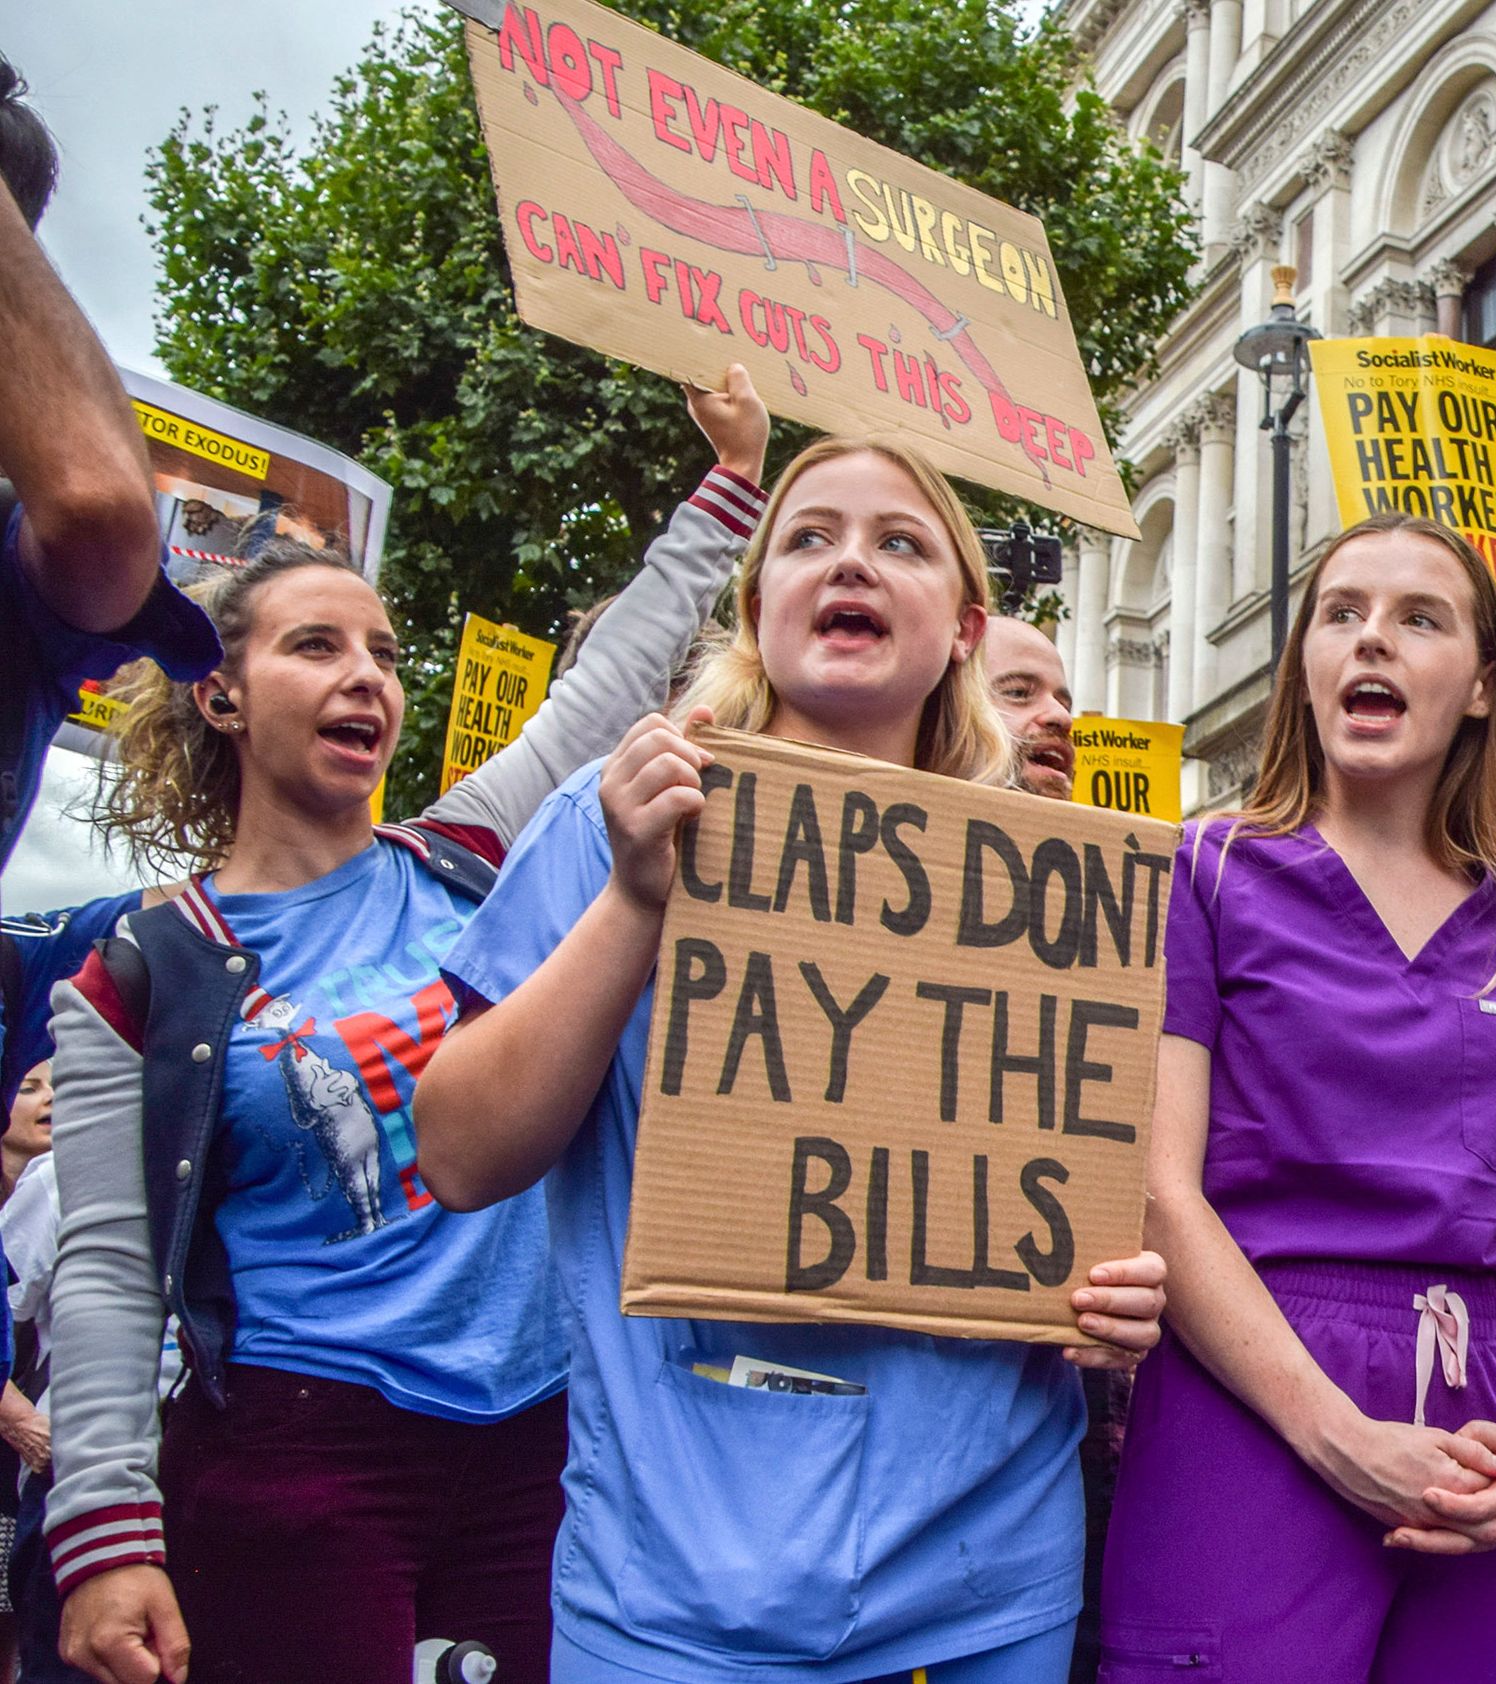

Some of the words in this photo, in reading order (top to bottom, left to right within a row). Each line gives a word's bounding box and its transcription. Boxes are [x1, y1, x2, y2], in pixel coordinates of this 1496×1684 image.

[498, 1, 623, 120] NOT
[647, 67, 797, 201] EVEN
[809, 147, 848, 225] A
[846, 168, 1058, 320] SURGEON
[515, 200, 626, 291] CAN
[639, 246, 734, 335] FIX
[739, 289, 842, 373] CUTS
[857, 333, 972, 425] THIS
[988, 390, 1095, 478] DEEP
[1344, 376, 1365, 388] No
[1369, 376, 1384, 387] to
[1389, 375, 1418, 390] Tory
[1423, 374, 1456, 388] NHS
[1347, 390, 1419, 435] PAY
[138, 410, 180, 440] TOR
[184, 428, 267, 474] EXODUS!
[1354, 438, 1495, 487] HEALTH
[462, 658, 492, 697] PAY
[496, 670, 528, 709] OUR
[456, 695, 512, 740] HEALTH
[1081, 753, 1110, 767] NHS
[1091, 769, 1151, 814] OUR
[680, 764, 931, 937] CLAPS
[956, 819, 1171, 969] DON'T
[660, 937, 890, 1103] PAY
[916, 981, 1139, 1144] THE
[785, 1136, 1076, 1291] BILLS
